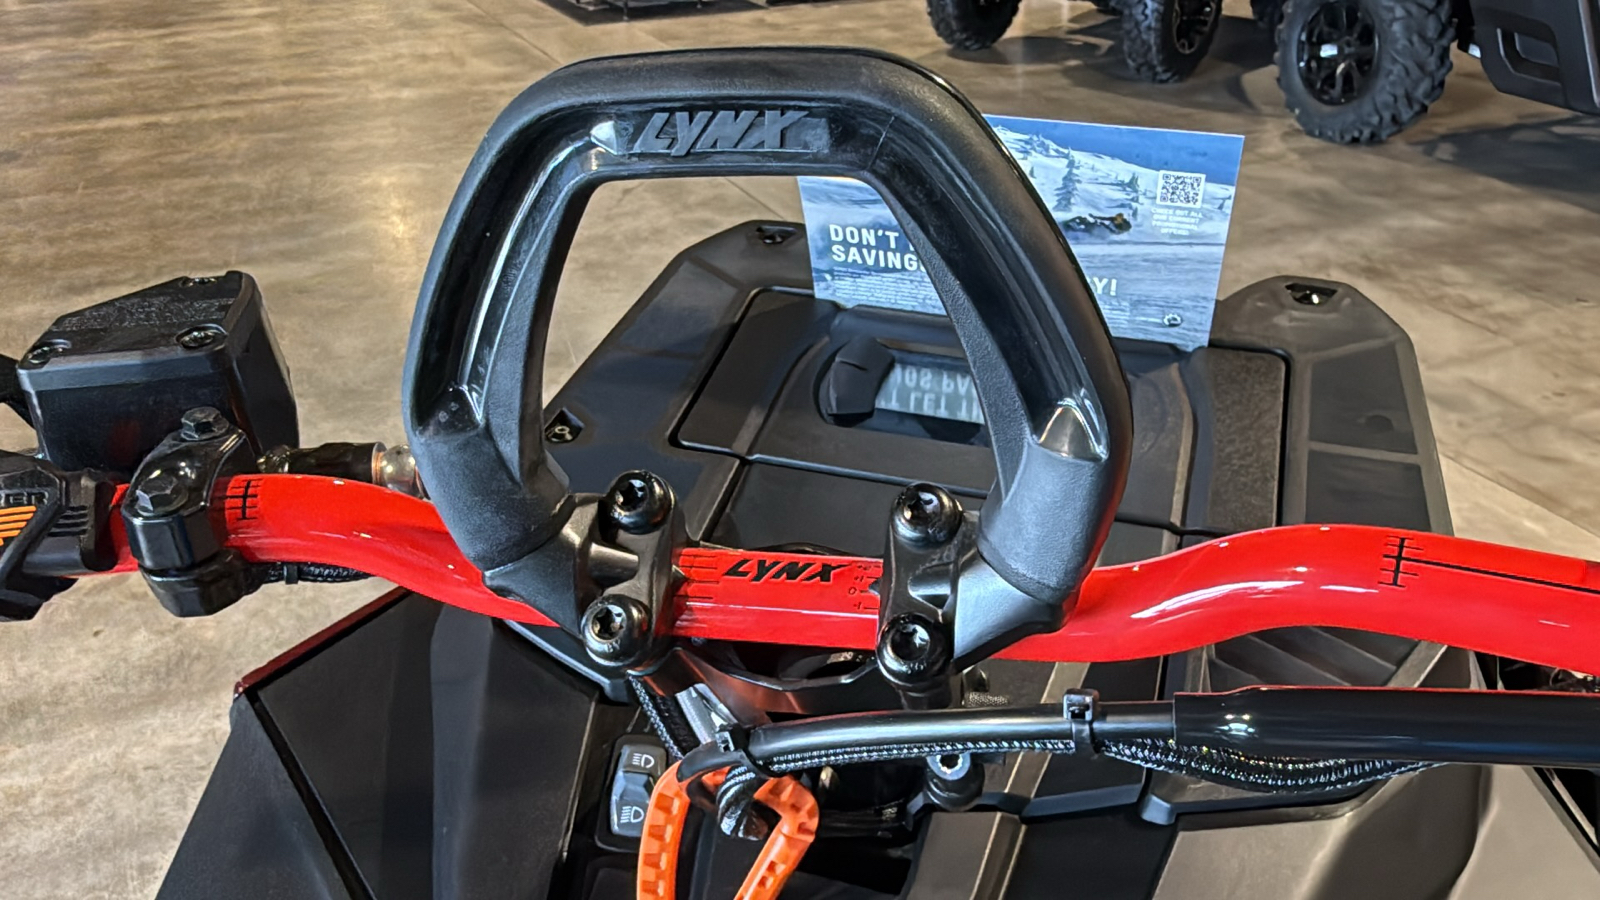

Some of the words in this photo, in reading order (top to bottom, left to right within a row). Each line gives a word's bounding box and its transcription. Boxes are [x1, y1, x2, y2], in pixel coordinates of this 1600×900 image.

[633, 110, 809, 157] LYNX
[829, 224, 899, 249] DON'T
[724, 558, 852, 583] LYNX
